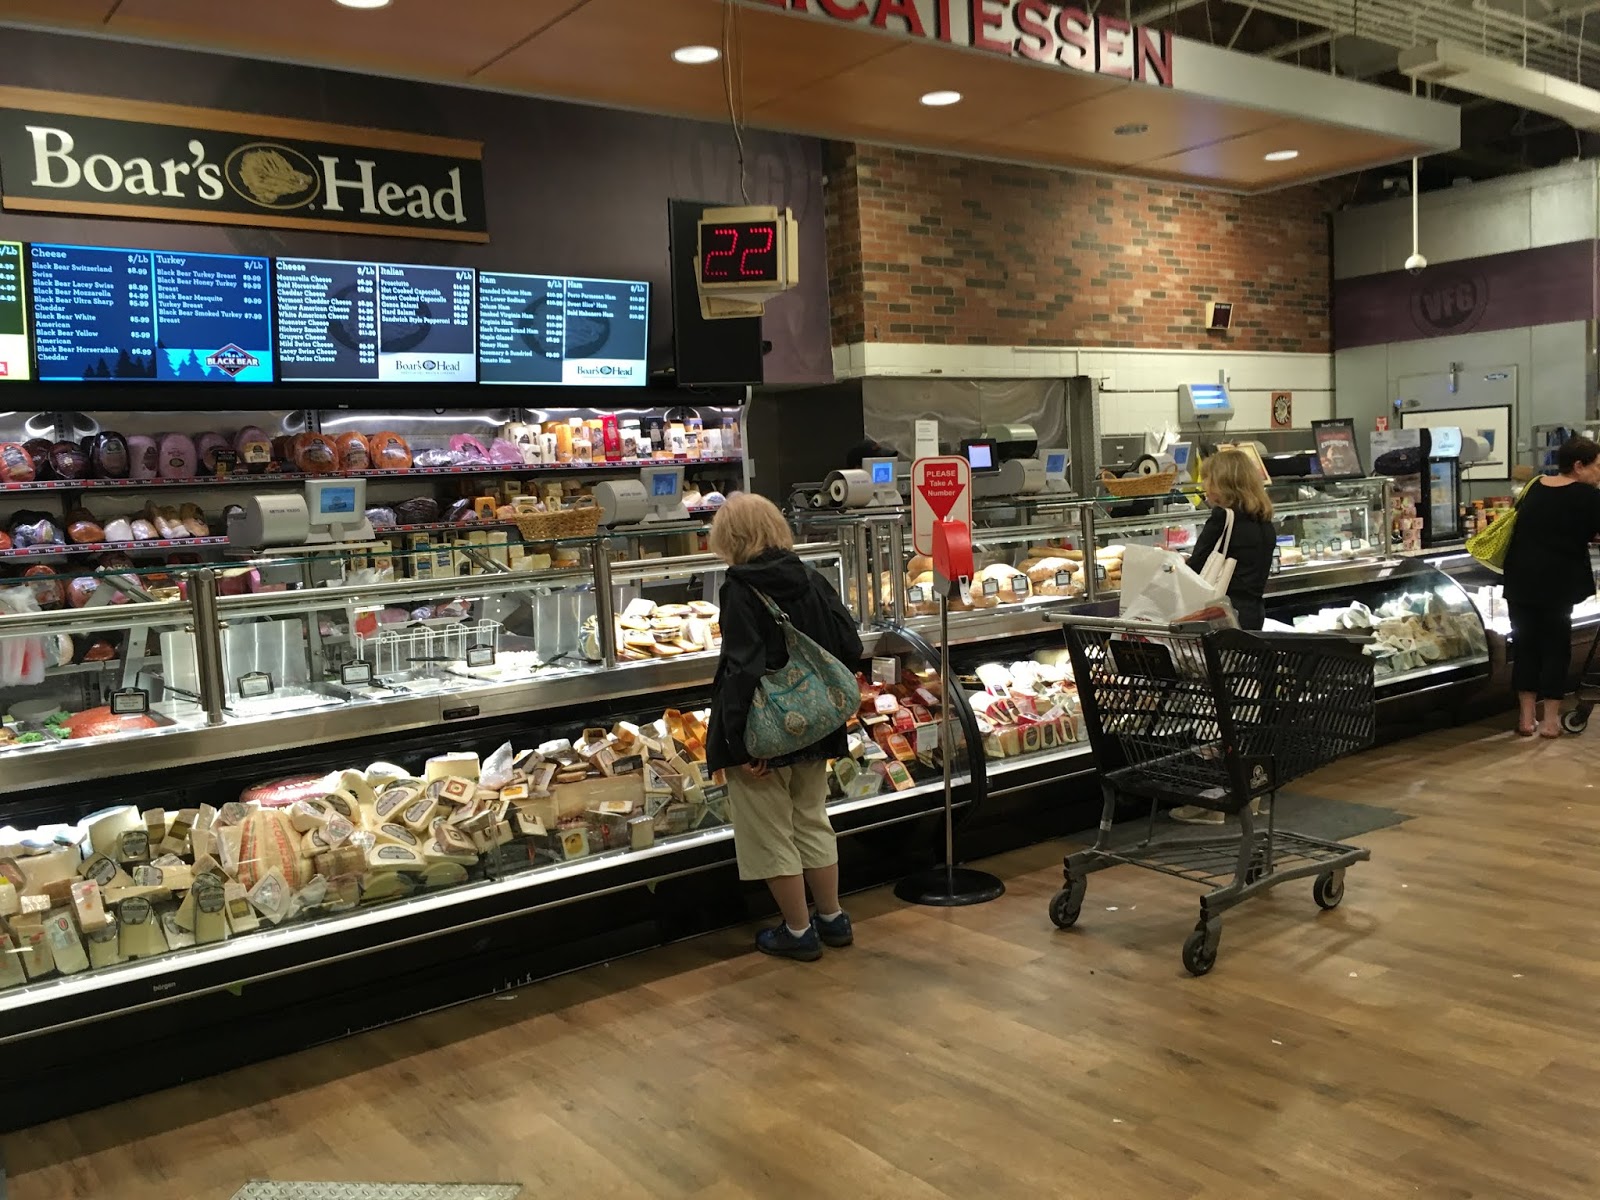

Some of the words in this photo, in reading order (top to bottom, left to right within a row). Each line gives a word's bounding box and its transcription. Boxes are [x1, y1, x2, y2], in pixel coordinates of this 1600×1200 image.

[758, 0, 1173, 87] ATESSEN
[25, 125, 224, 201] Boar's
[317, 155, 467, 224] Head
[31, 248, 67, 258] Cheese
[704, 227, 773, 276] 22
[128, 254, 148, 264] $/Lb
[156, 255, 186, 266] Turkey
[72, 264, 112, 272] Switzerland
[244, 261, 263, 271] $/Lb
[276, 262, 306, 271] Cheese
[193, 271, 215, 279] Turkey
[380, 267, 404, 276] Italian
[72, 281, 92, 289] Lacey
[193, 279, 214, 287] Honey
[215, 280, 237, 288] Turkey
[568, 281, 583, 289] Ham
[194, 294, 223, 303] Mesquite
[221, 311, 242, 319] Turkey
[396, 360, 422, 370] Boar's
[437, 361, 460, 371] Head
[577, 366, 599, 375] Boar's
[612, 366, 632, 375] Head
